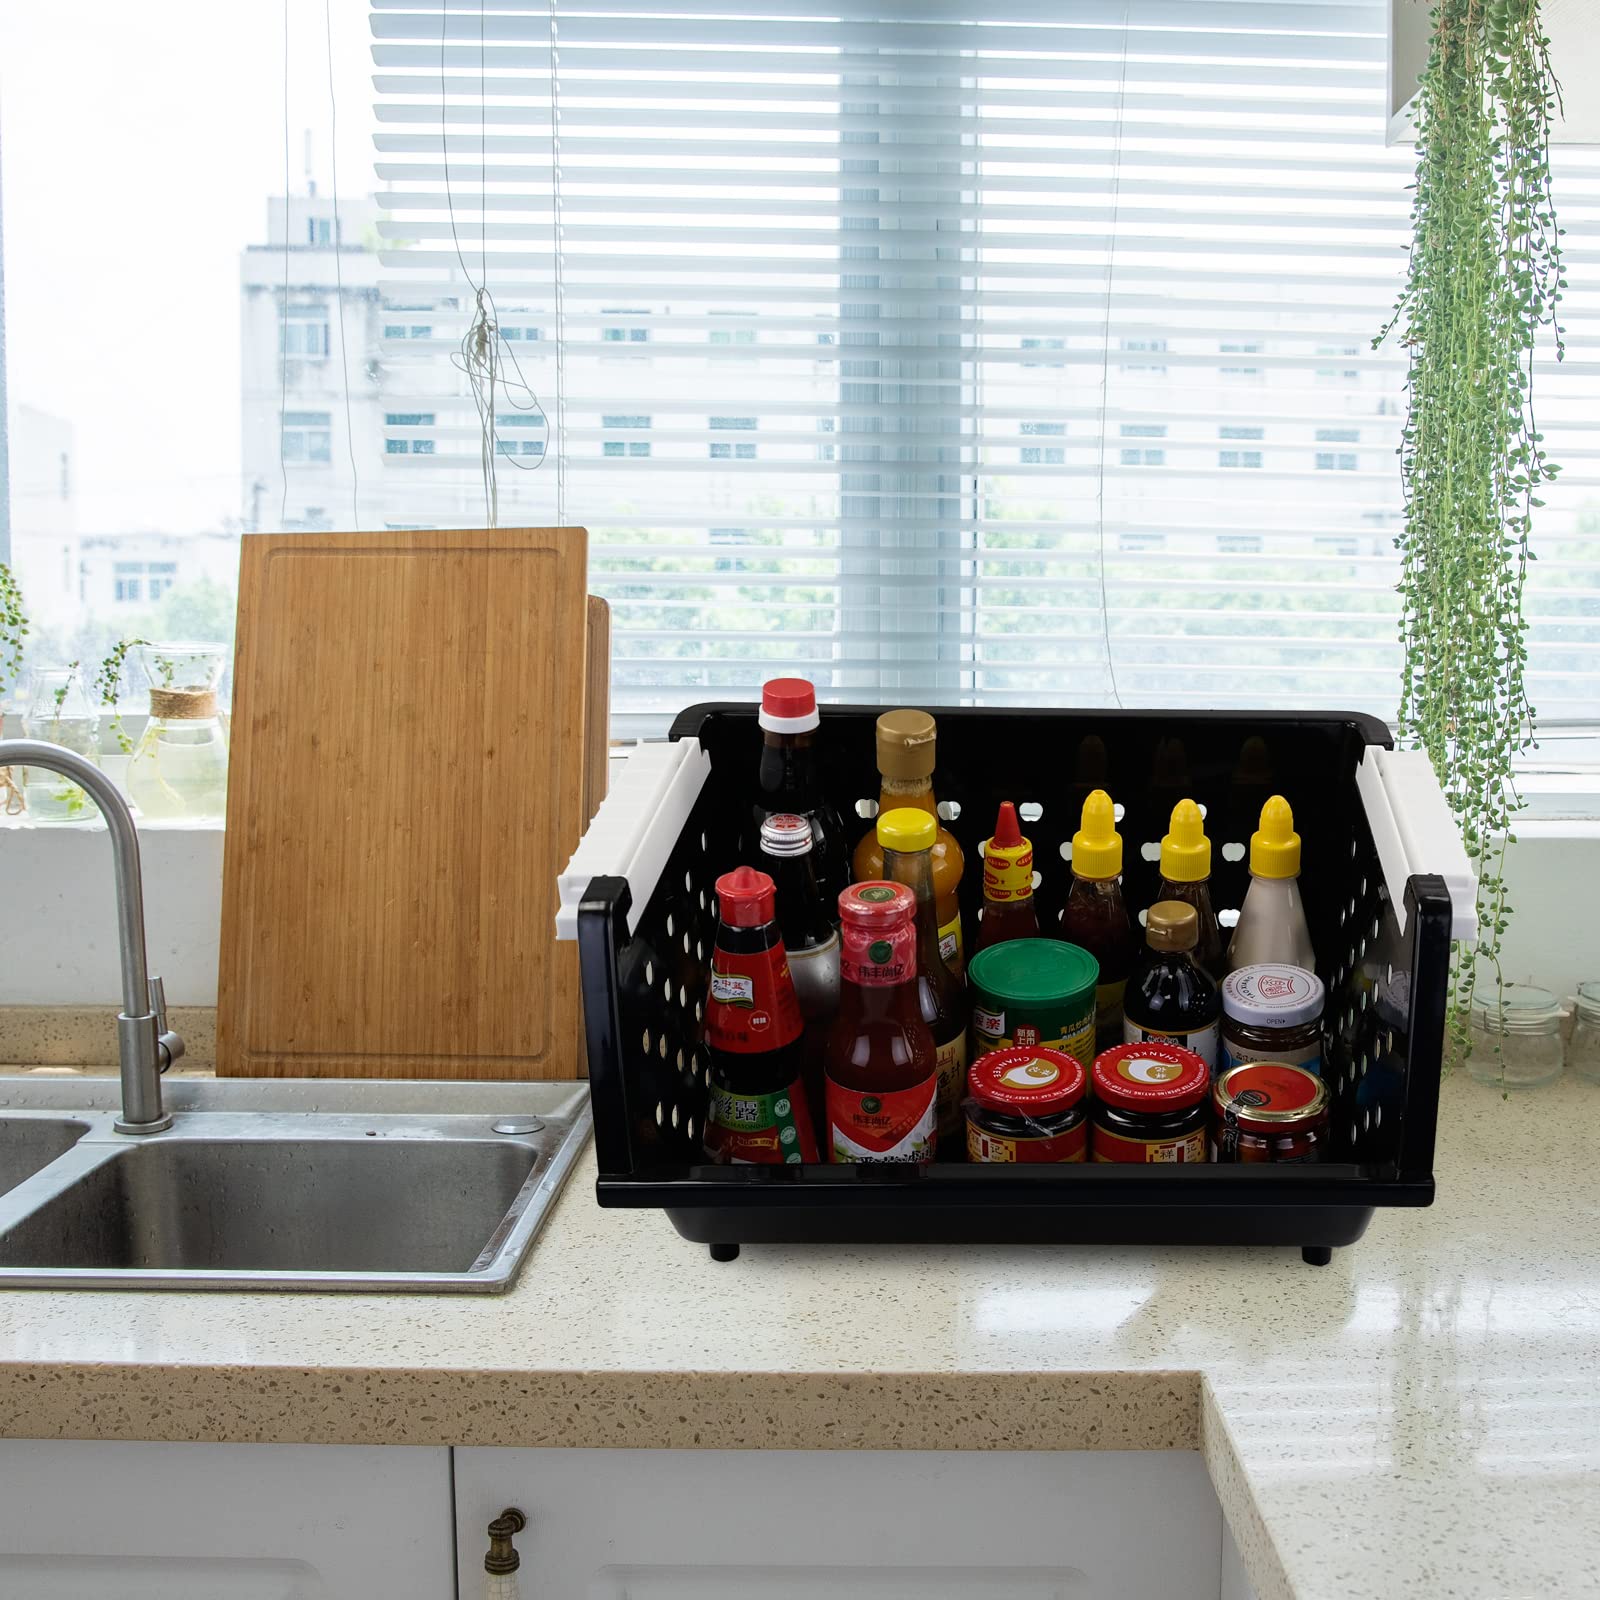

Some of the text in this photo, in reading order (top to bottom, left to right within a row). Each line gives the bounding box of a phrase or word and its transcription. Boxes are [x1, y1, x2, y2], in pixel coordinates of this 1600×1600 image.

[858, 965, 904, 979] 伟丰尚亿
[1017, 1037, 1036, 1046] 上市
[1126, 1051, 1179, 1063] CHANKEE
[992, 1056, 1030, 1079] CHANKEE
[853, 1113, 891, 1126] 伟丰尚亿
[1159, 1143, 1197, 1160] 祥记
